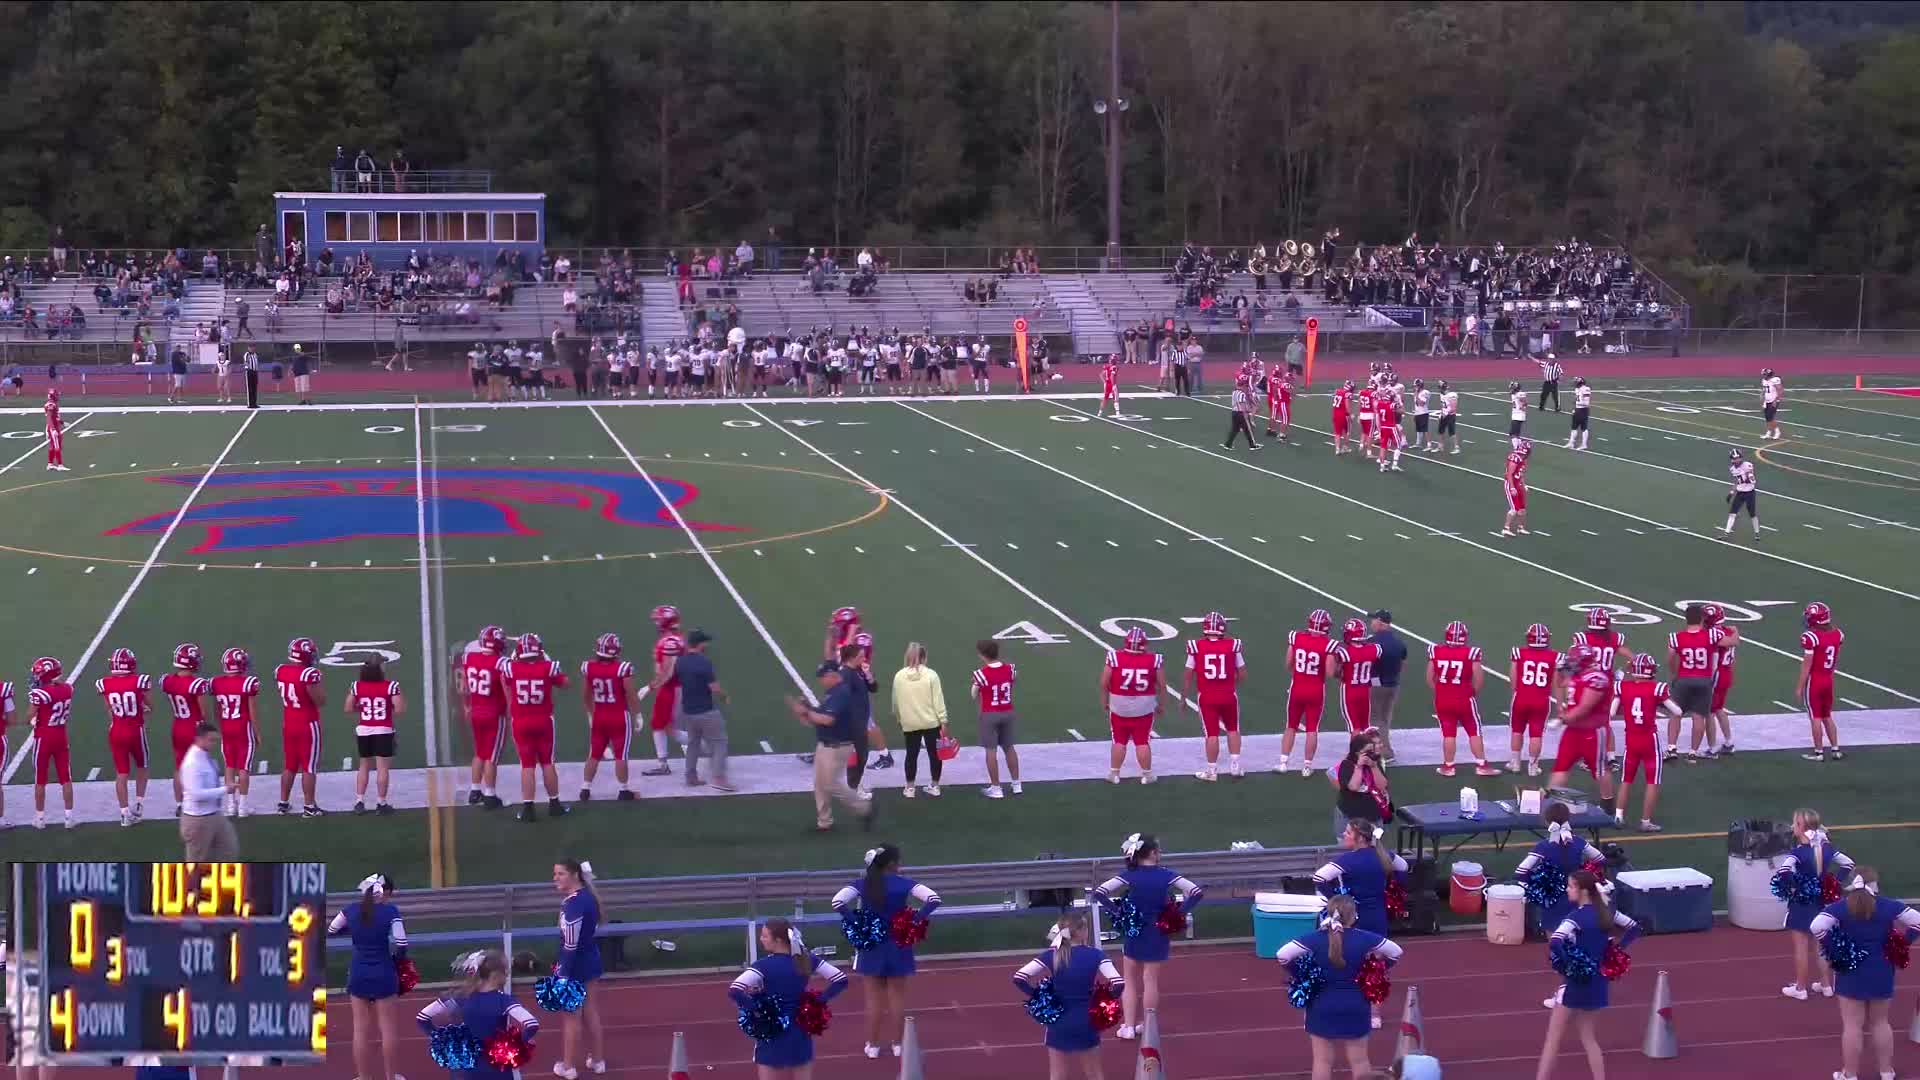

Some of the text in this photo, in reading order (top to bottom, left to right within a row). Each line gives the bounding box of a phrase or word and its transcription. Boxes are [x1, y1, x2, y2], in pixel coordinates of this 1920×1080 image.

[1204, 654, 1228, 680] 51
[1295, 648, 1320, 675] 82
[1682, 647, 1708, 670] 39
[1824, 646, 1835, 669] 3
[466, 666, 490, 696] 62
[1120, 668, 1149, 692] 75
[1351, 661, 1372, 684] 10
[1437, 660, 1464, 685] 77
[1522, 660, 1550, 687] 66
[277, 681, 301, 709] 74
[516, 680, 545, 705] 55
[592, 678, 616, 703] 21
[991, 682, 1012, 706] 13
[360, 696, 387, 721] 38
[1631, 697, 1644, 724] 4
